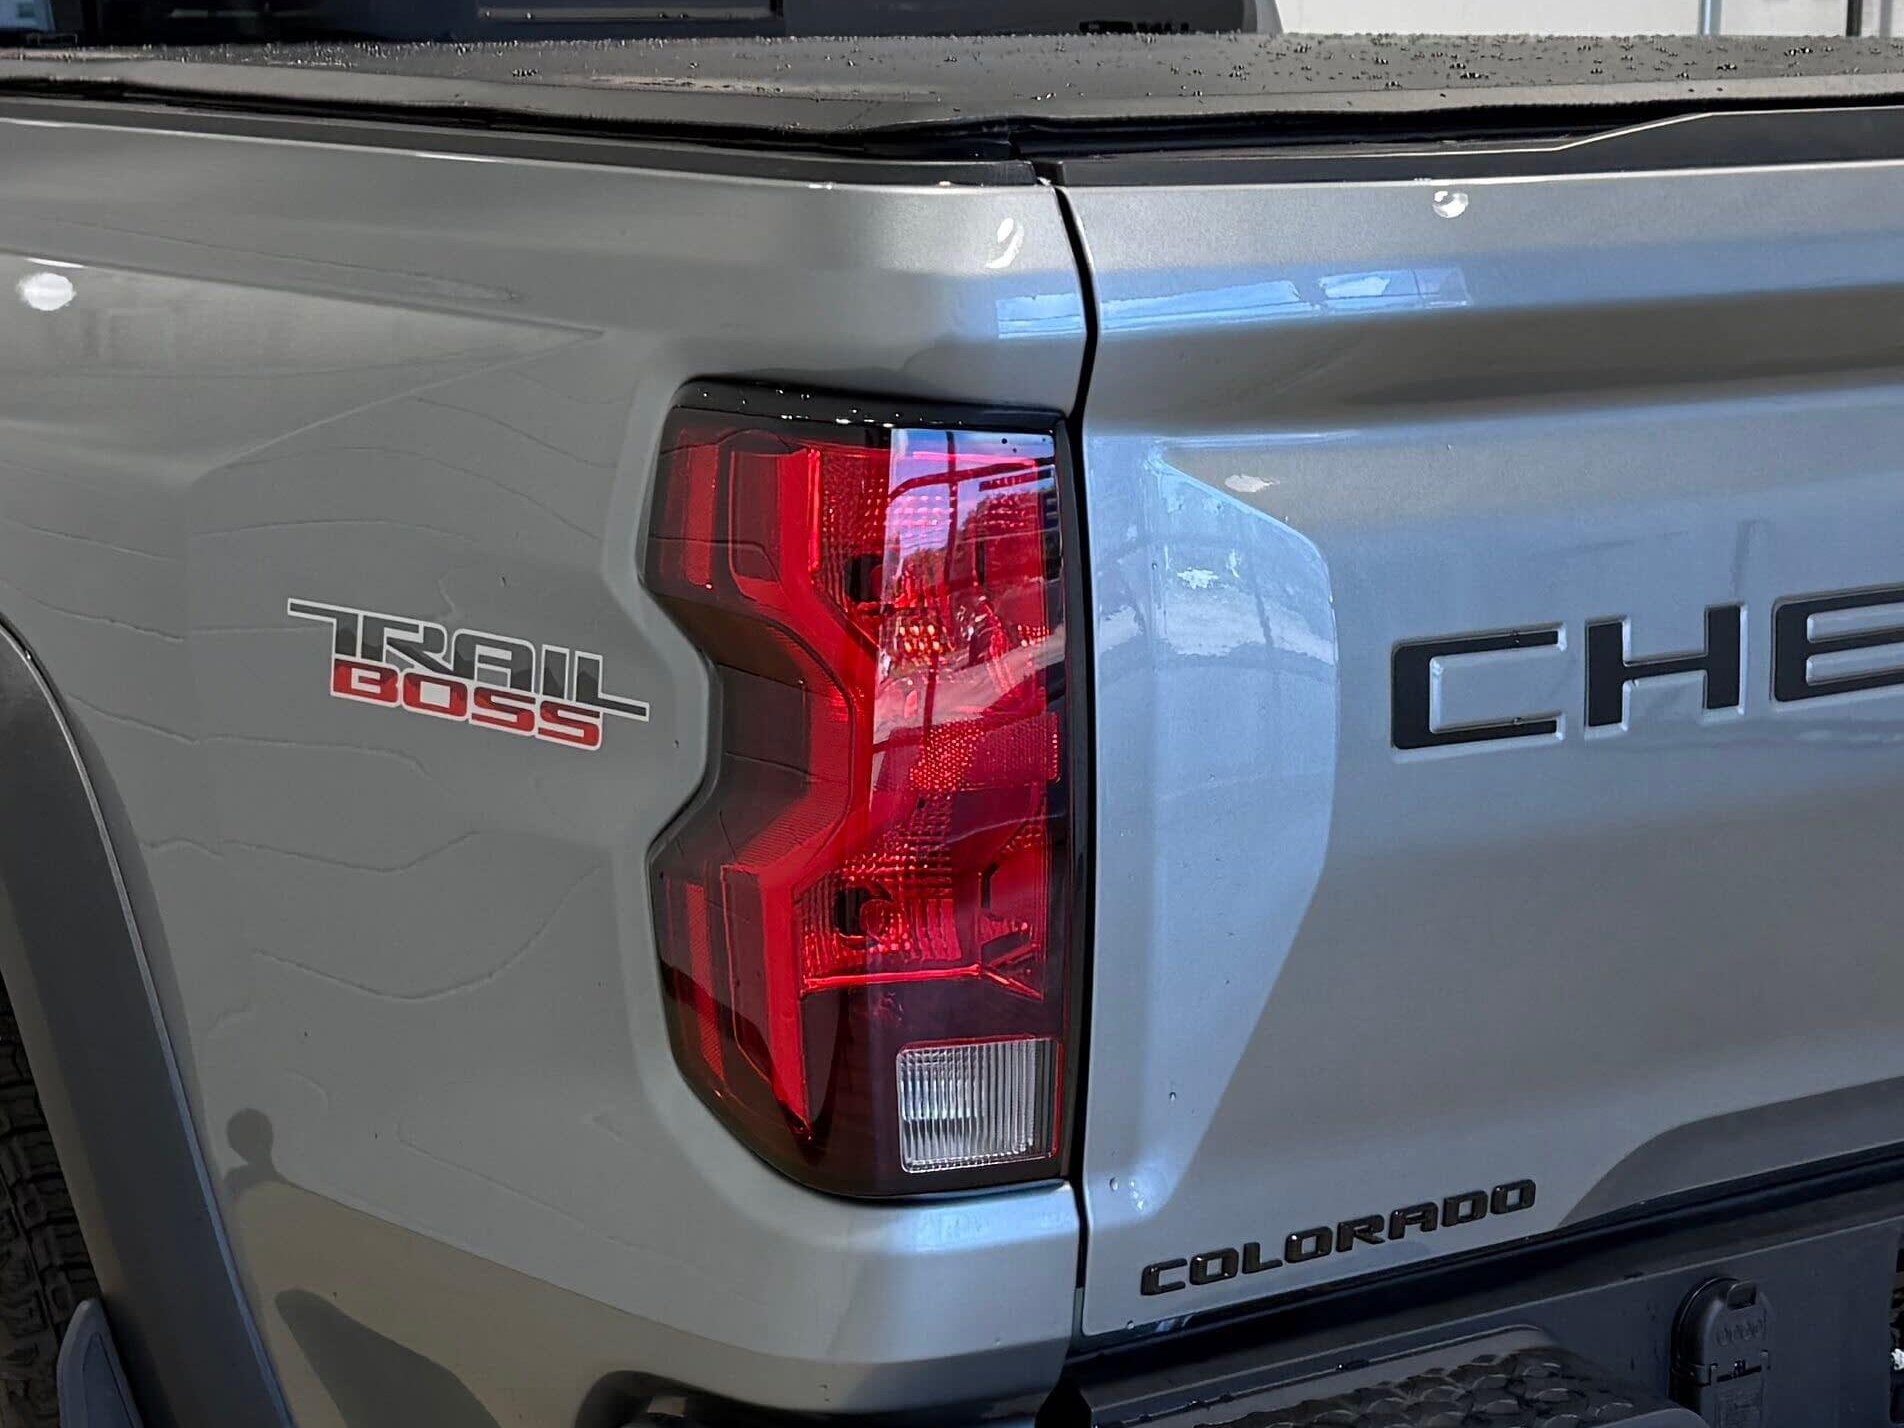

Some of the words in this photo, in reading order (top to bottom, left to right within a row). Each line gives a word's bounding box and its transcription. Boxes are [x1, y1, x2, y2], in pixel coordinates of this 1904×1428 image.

[287, 597, 651, 723] TRAIL
[329, 656, 602, 751] BOSS
[1140, 1178, 1537, 1296] COLORADO
